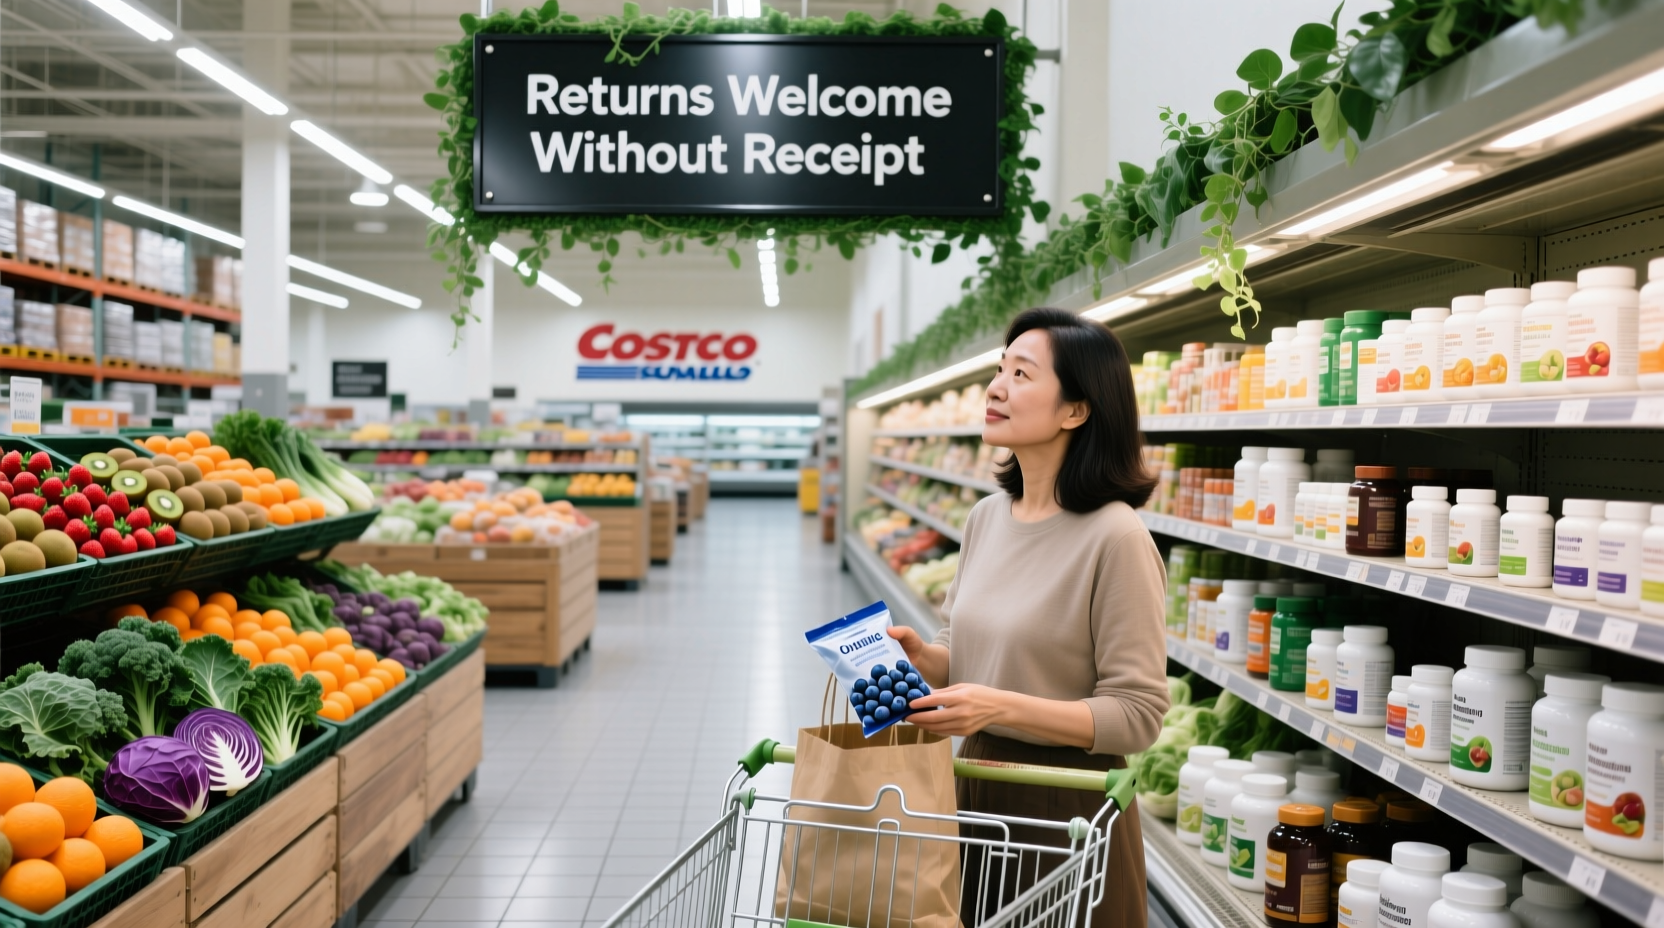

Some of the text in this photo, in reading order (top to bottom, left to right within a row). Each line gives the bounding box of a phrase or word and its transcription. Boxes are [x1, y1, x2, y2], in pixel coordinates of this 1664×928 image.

[528, 75, 951, 116] Returns Welcome
[531, 131, 924, 185] Without Receipt
